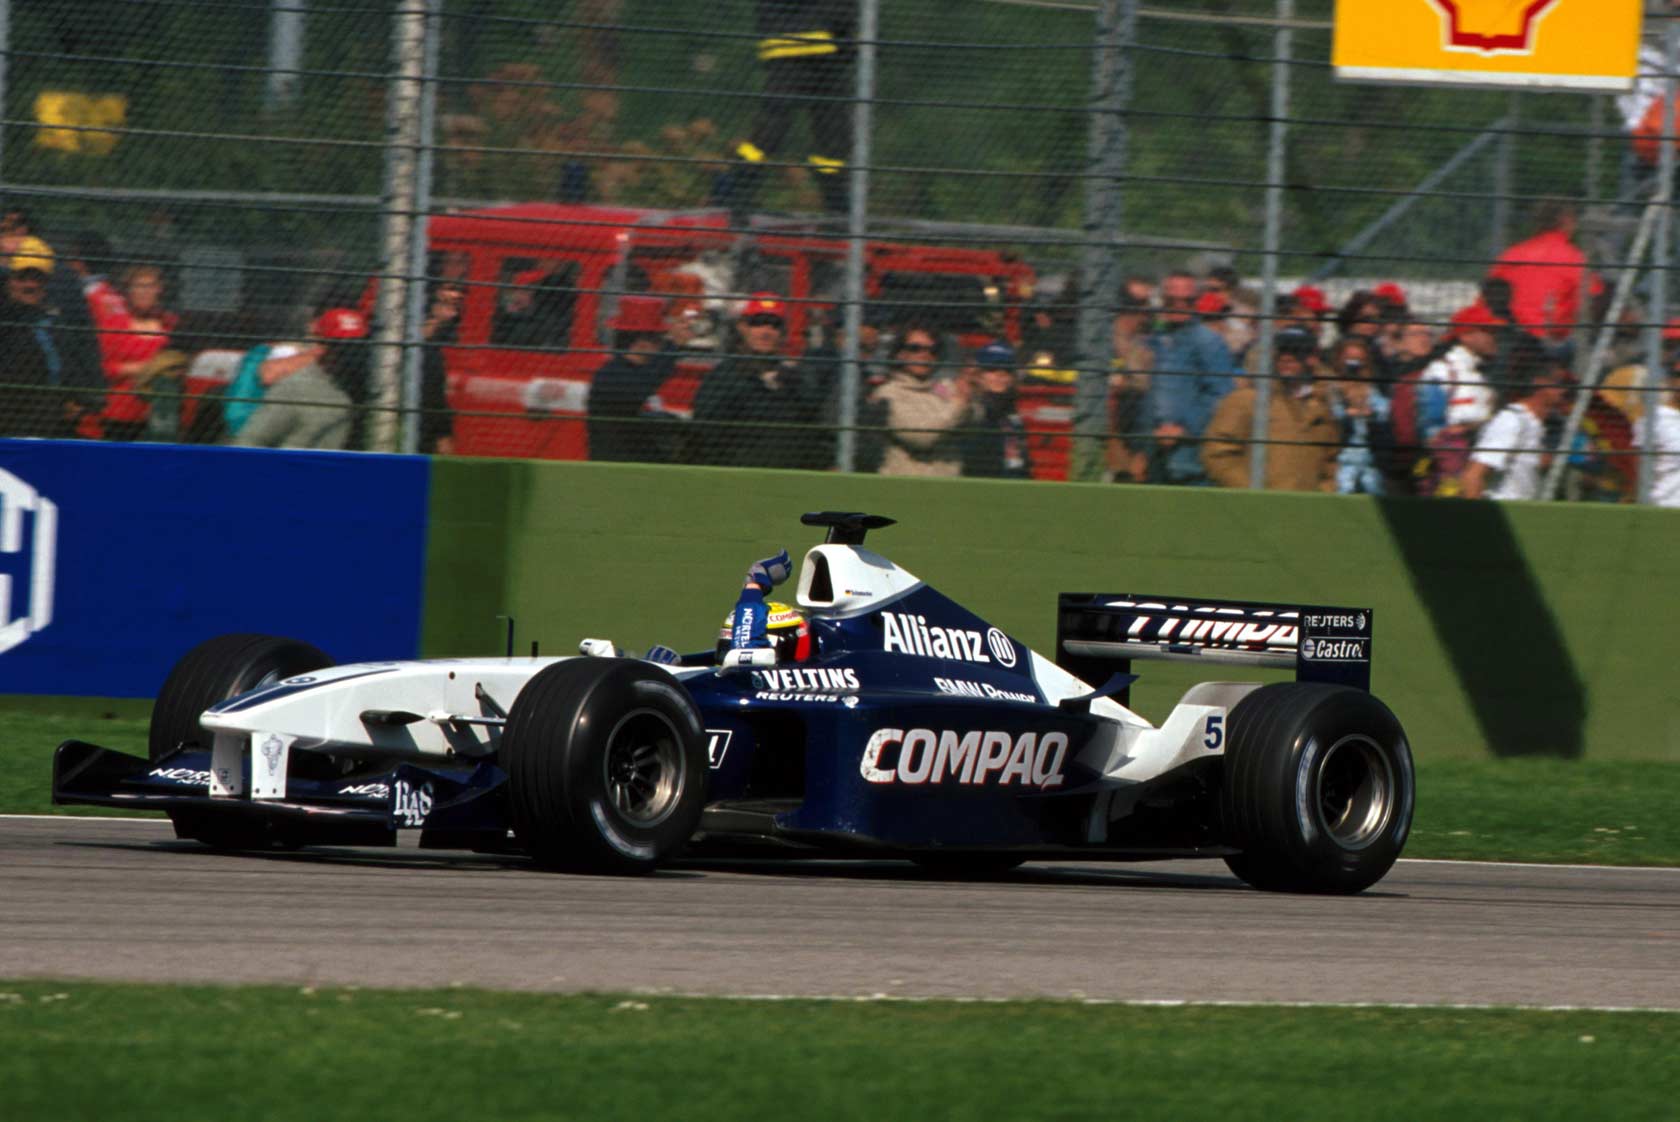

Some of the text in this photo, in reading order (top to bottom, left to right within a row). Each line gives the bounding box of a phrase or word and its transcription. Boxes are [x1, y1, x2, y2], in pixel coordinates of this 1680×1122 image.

[1304, 615, 1354, 627] REUTERS
[881, 611, 990, 663] Allianz
[1316, 640, 1364, 658] Castrol
[761, 668, 860, 690] VELTINS
[755, 691, 838, 702] REUTERS
[1203, 715, 1223, 749] 5
[859, 728, 1069, 791] COMPAQ
